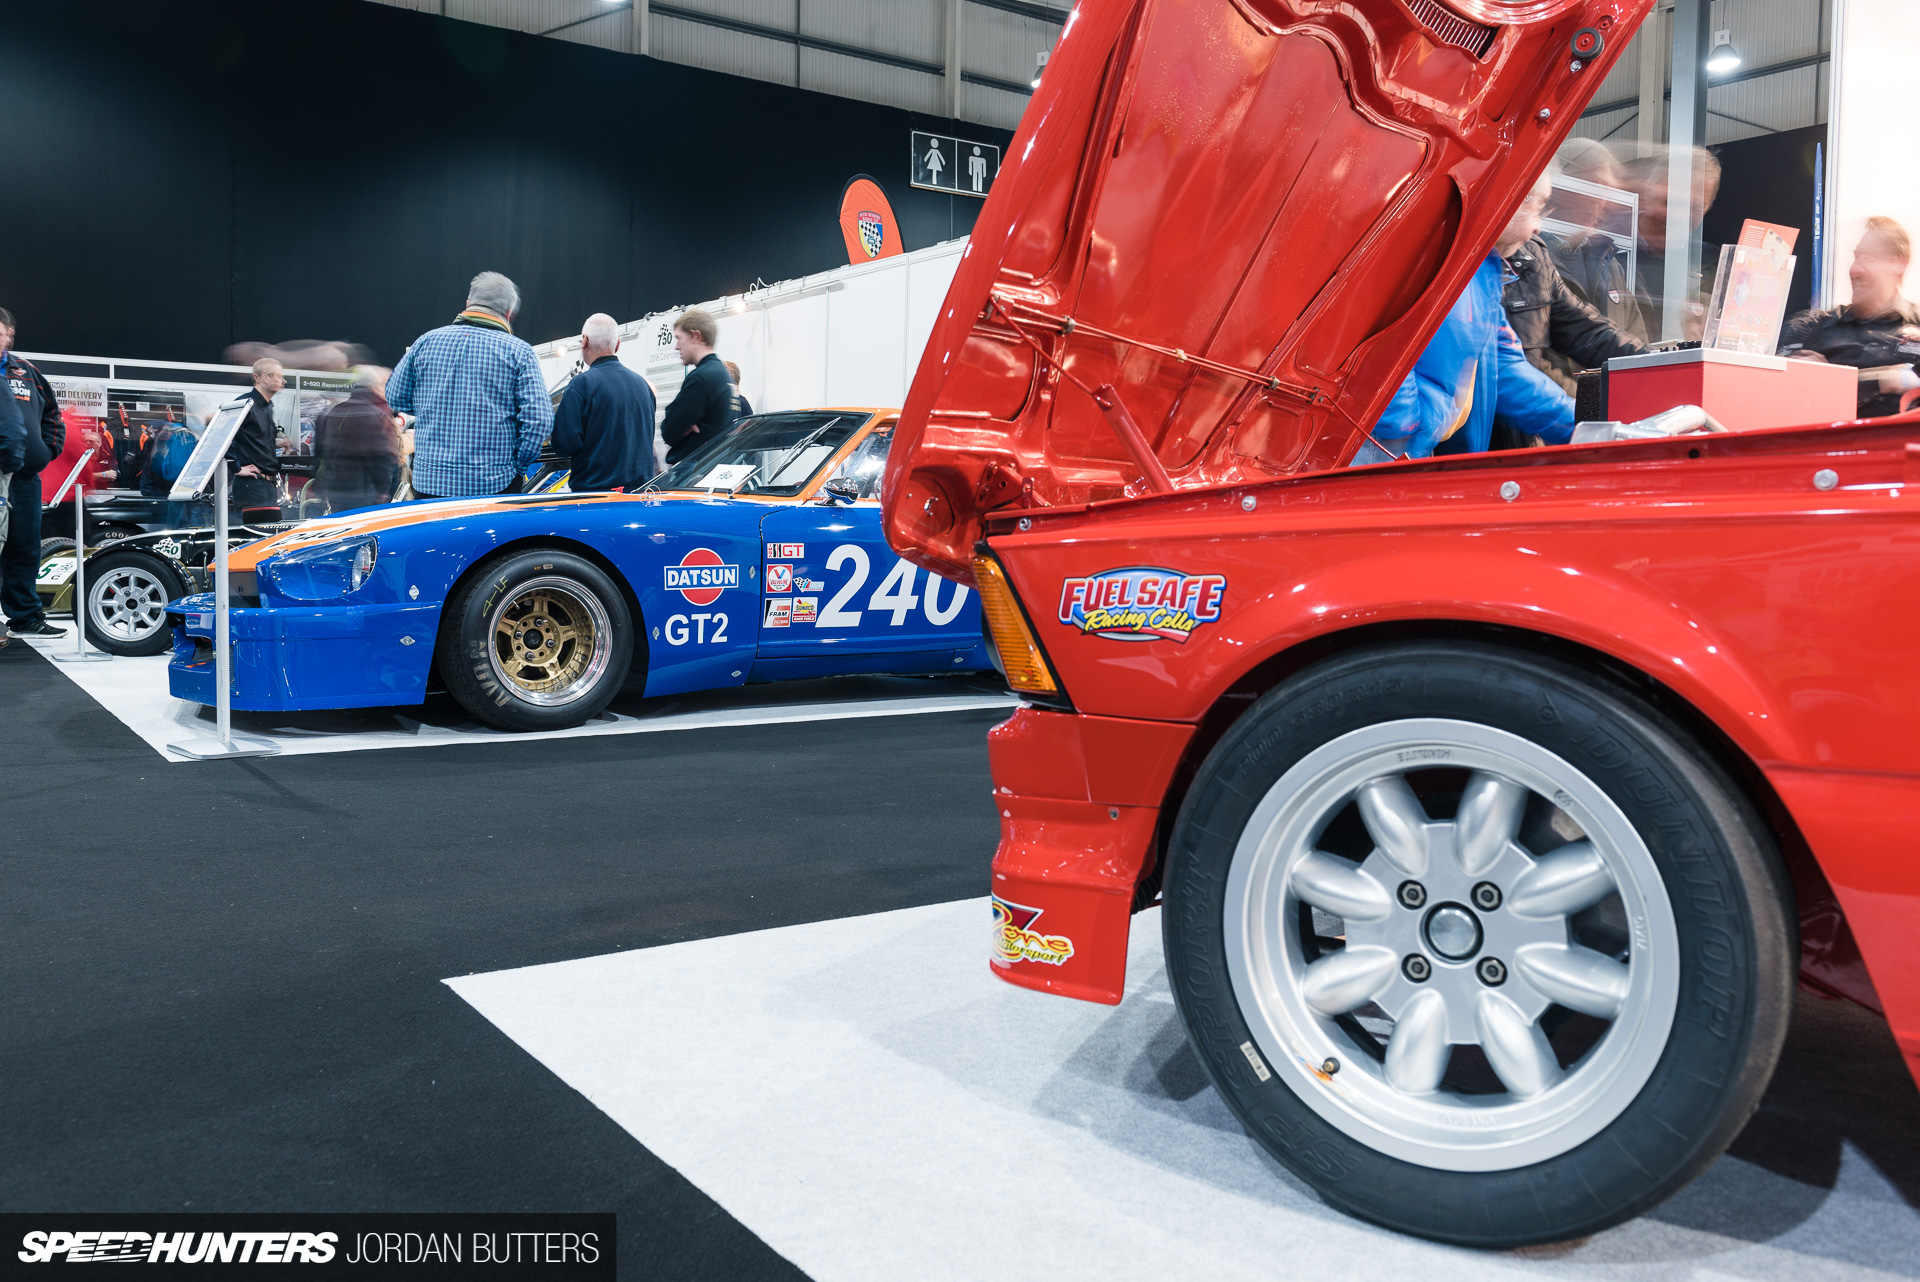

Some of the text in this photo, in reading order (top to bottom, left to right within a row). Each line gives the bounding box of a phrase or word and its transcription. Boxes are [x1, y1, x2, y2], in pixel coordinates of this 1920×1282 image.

[657, 331, 673, 346] 750
[68, 391, 102, 400] DELIVERY
[783, 545, 803, 556] GT
[667, 568, 736, 587] DATSUN
[814, 544, 971, 628] 240
[1059, 574, 1227, 622] FUEL SAFE
[665, 613, 728, 645] GT2
[1083, 608, 1195, 632] Racing Cells
[1568, 724, 1739, 1041] DUNLOP
